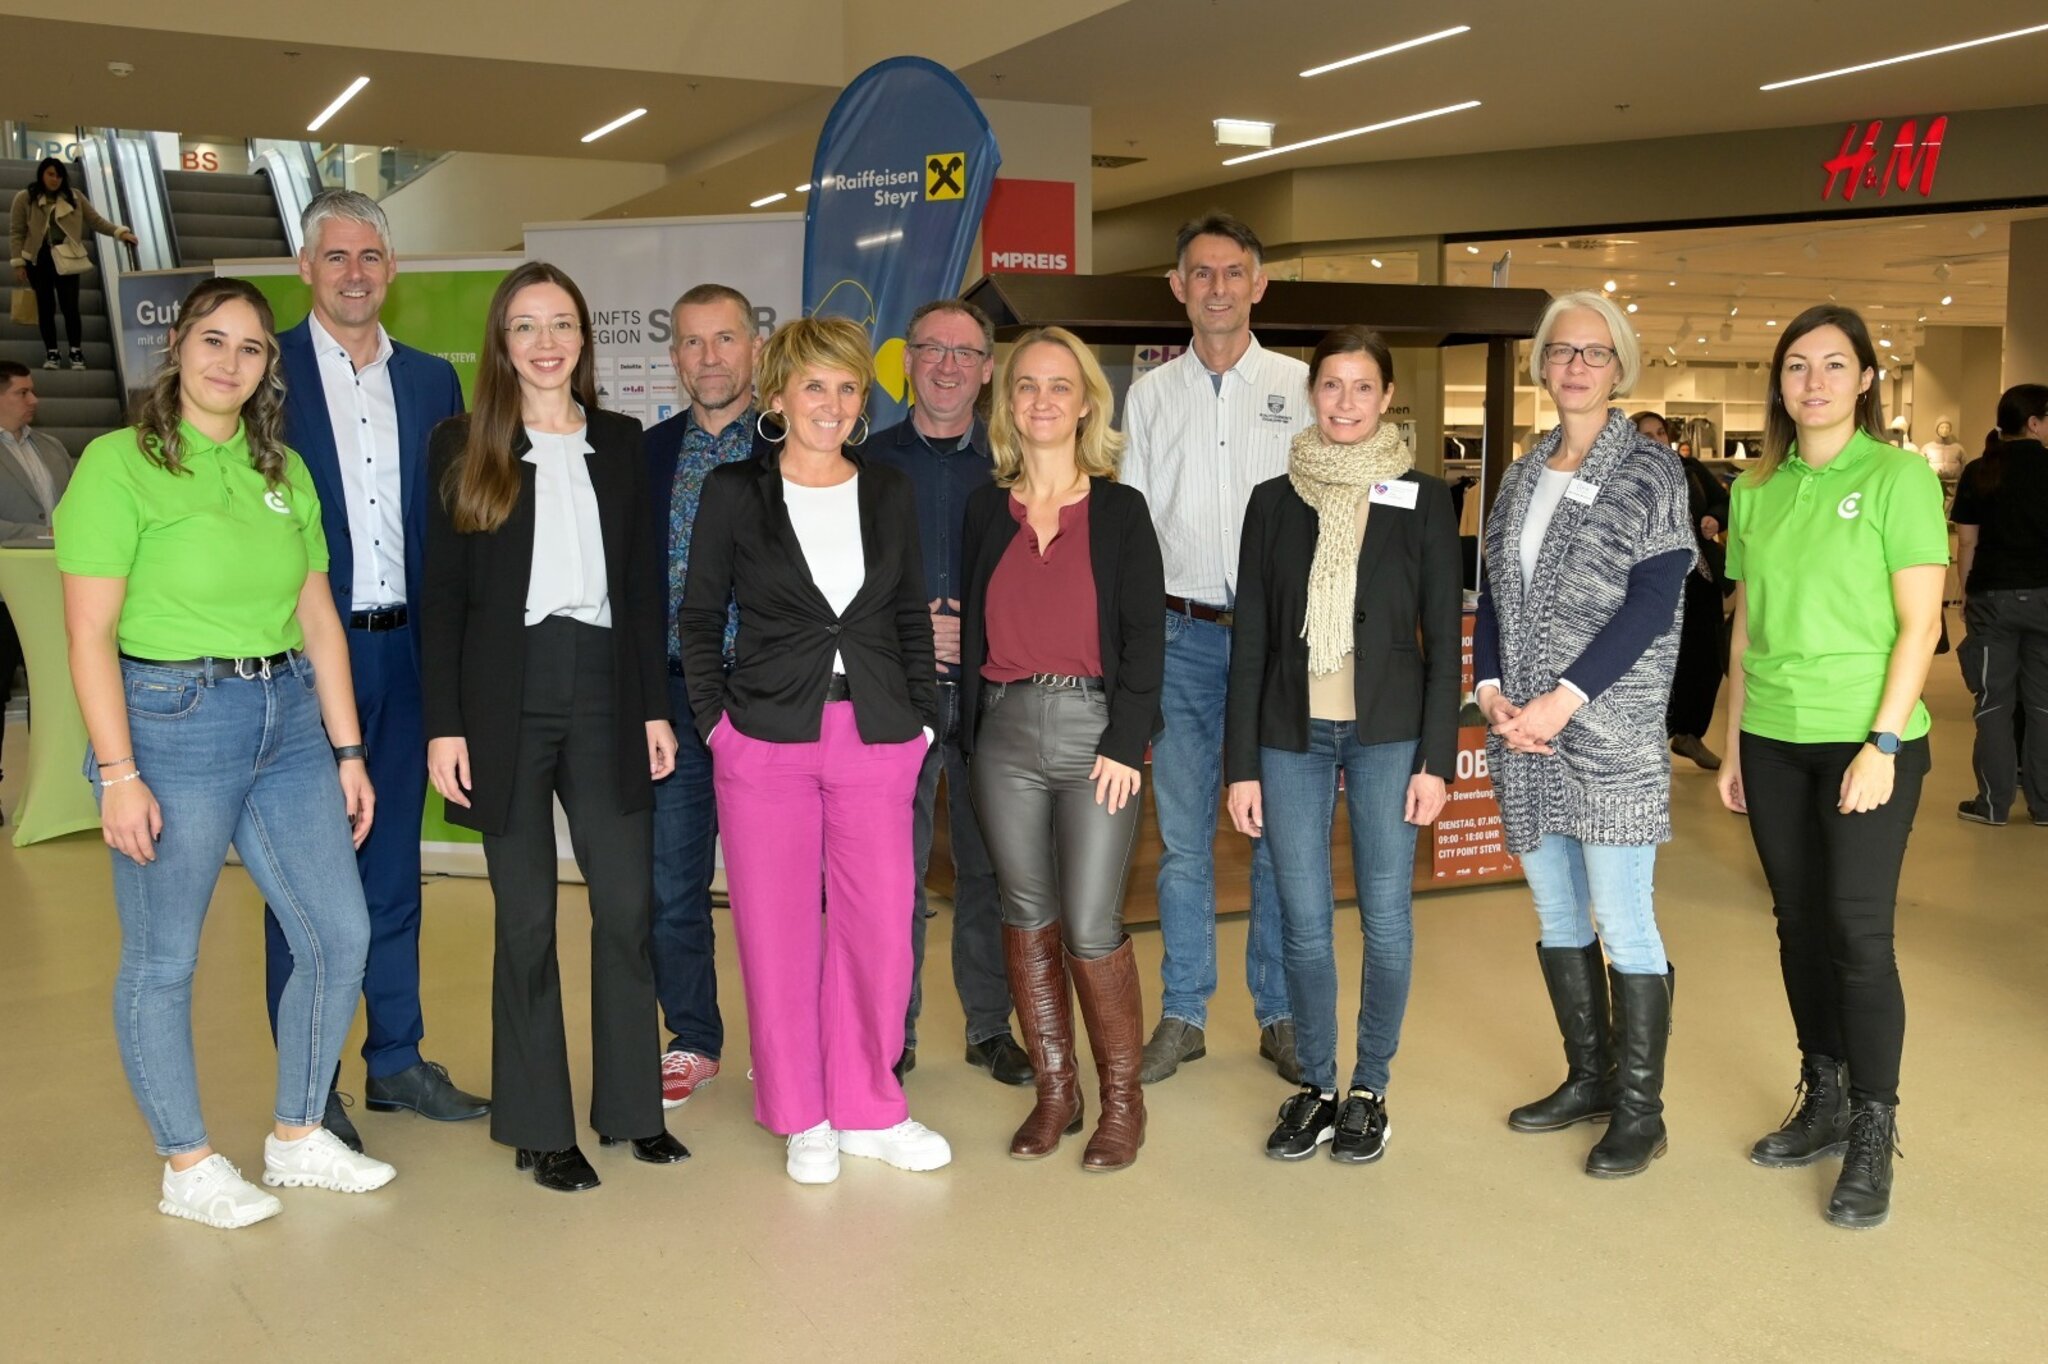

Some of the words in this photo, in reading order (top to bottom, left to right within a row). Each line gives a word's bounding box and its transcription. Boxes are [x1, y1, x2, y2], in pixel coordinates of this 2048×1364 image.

[1822, 115, 1948, 202] H&M
[835, 169, 919, 191] Raiffeisen
[874, 189, 918, 209] Steyr
[991, 252, 1068, 270] MPREIS
[1438, 818, 1477, 831] DIENSTAG,
[1438, 834, 1459, 845] 09:00
[1465, 831, 1484, 842] 18:00
[1485, 829, 1500, 840] UHR
[1438, 848, 1455, 859] CITY
[1456, 845, 1478, 857] POINT
[1479, 843, 1502, 855] STEYR
